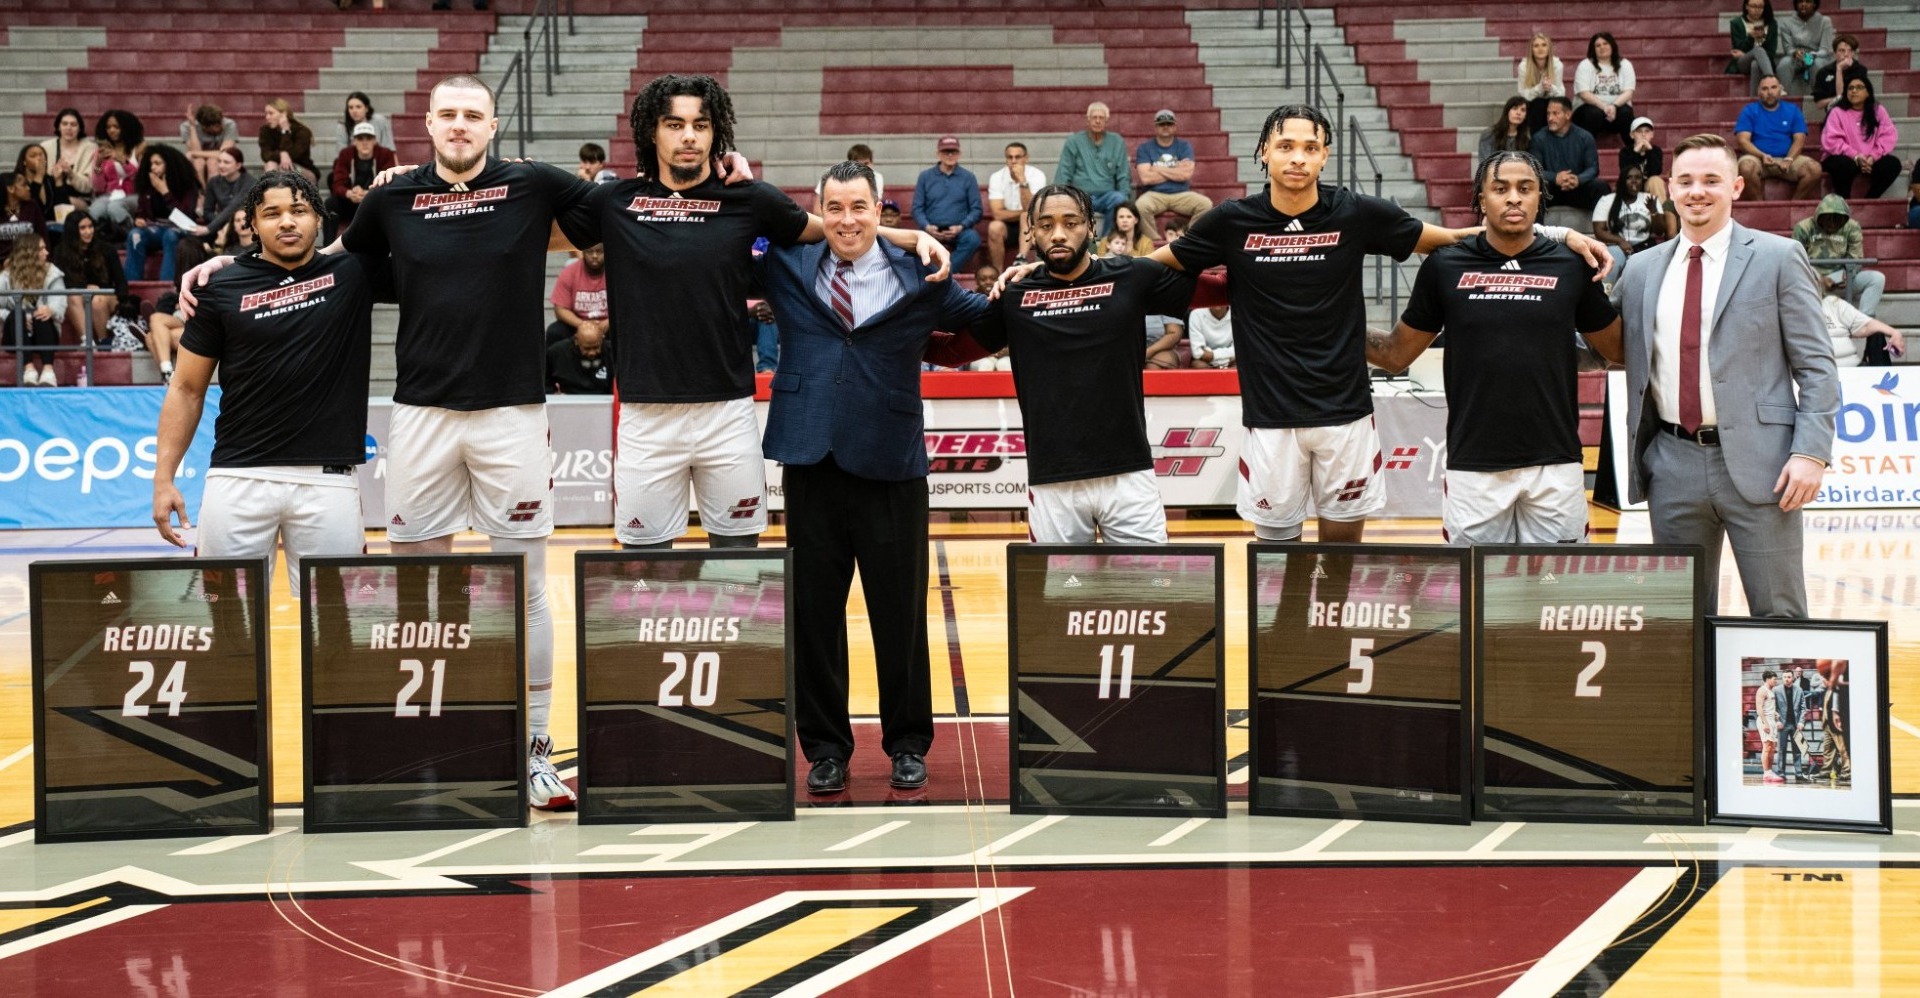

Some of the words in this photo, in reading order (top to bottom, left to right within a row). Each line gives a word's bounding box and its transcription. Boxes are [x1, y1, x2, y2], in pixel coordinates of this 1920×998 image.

[412, 185, 509, 210] HENDERSON
[626, 196, 721, 212] HENDERSON
[424, 206, 495, 219] BASKETBALL
[1244, 231, 1341, 251] HENDERSON
[1255, 254, 1326, 262] BASKETBALL
[240, 273, 334, 311] HENDERSON
[1457, 272, 1559, 289] HENDERSON
[255, 296, 326, 319] BASKETBALL
[1021, 282, 1114, 307] HENDERSON
[1468, 293, 1542, 301] BASKETBALL
[1033, 304, 1101, 317] BASKETBALL
[1825, 455, 1916, 475] STAT
[1066, 609, 1167, 636] REDDIES
[1310, 601, 1411, 629] REDDIES
[1540, 604, 1644, 631] REDDIES
[103, 624, 214, 651] REDDIES
[370, 621, 472, 650] REDDIES
[638, 616, 740, 642] REDDIES
[1098, 644, 1135, 699] 11
[1347, 637, 1375, 694] 5
[1575, 640, 1607, 697] 2
[122, 660, 188, 717] 24
[395, 659, 446, 717] 21
[658, 651, 720, 707] 20
